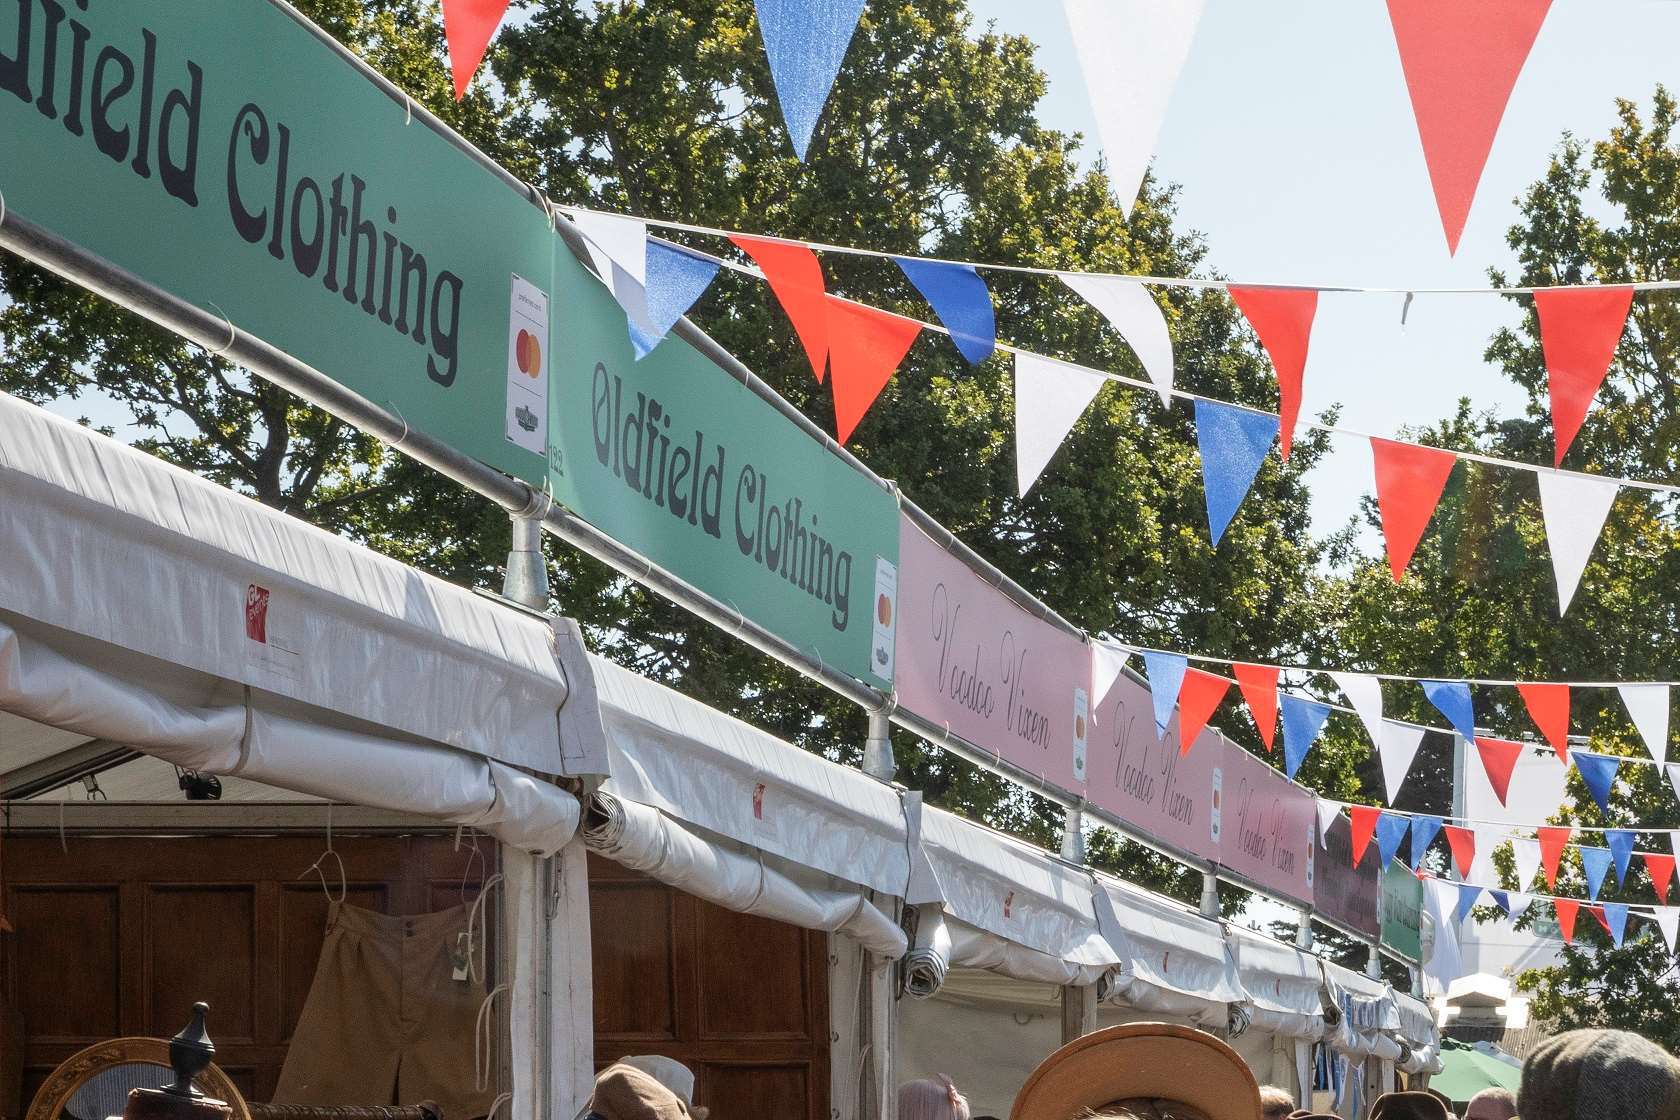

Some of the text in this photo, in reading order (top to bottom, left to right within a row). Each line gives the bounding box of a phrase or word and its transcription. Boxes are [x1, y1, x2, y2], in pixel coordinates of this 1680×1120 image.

[227, 103, 463, 388] Clothing
[591, 361, 852, 632] Oldfield Clothing
[931, 583, 1052, 750] Voodoo Vixen
[1113, 700, 1194, 826] Voodoo Vixen
